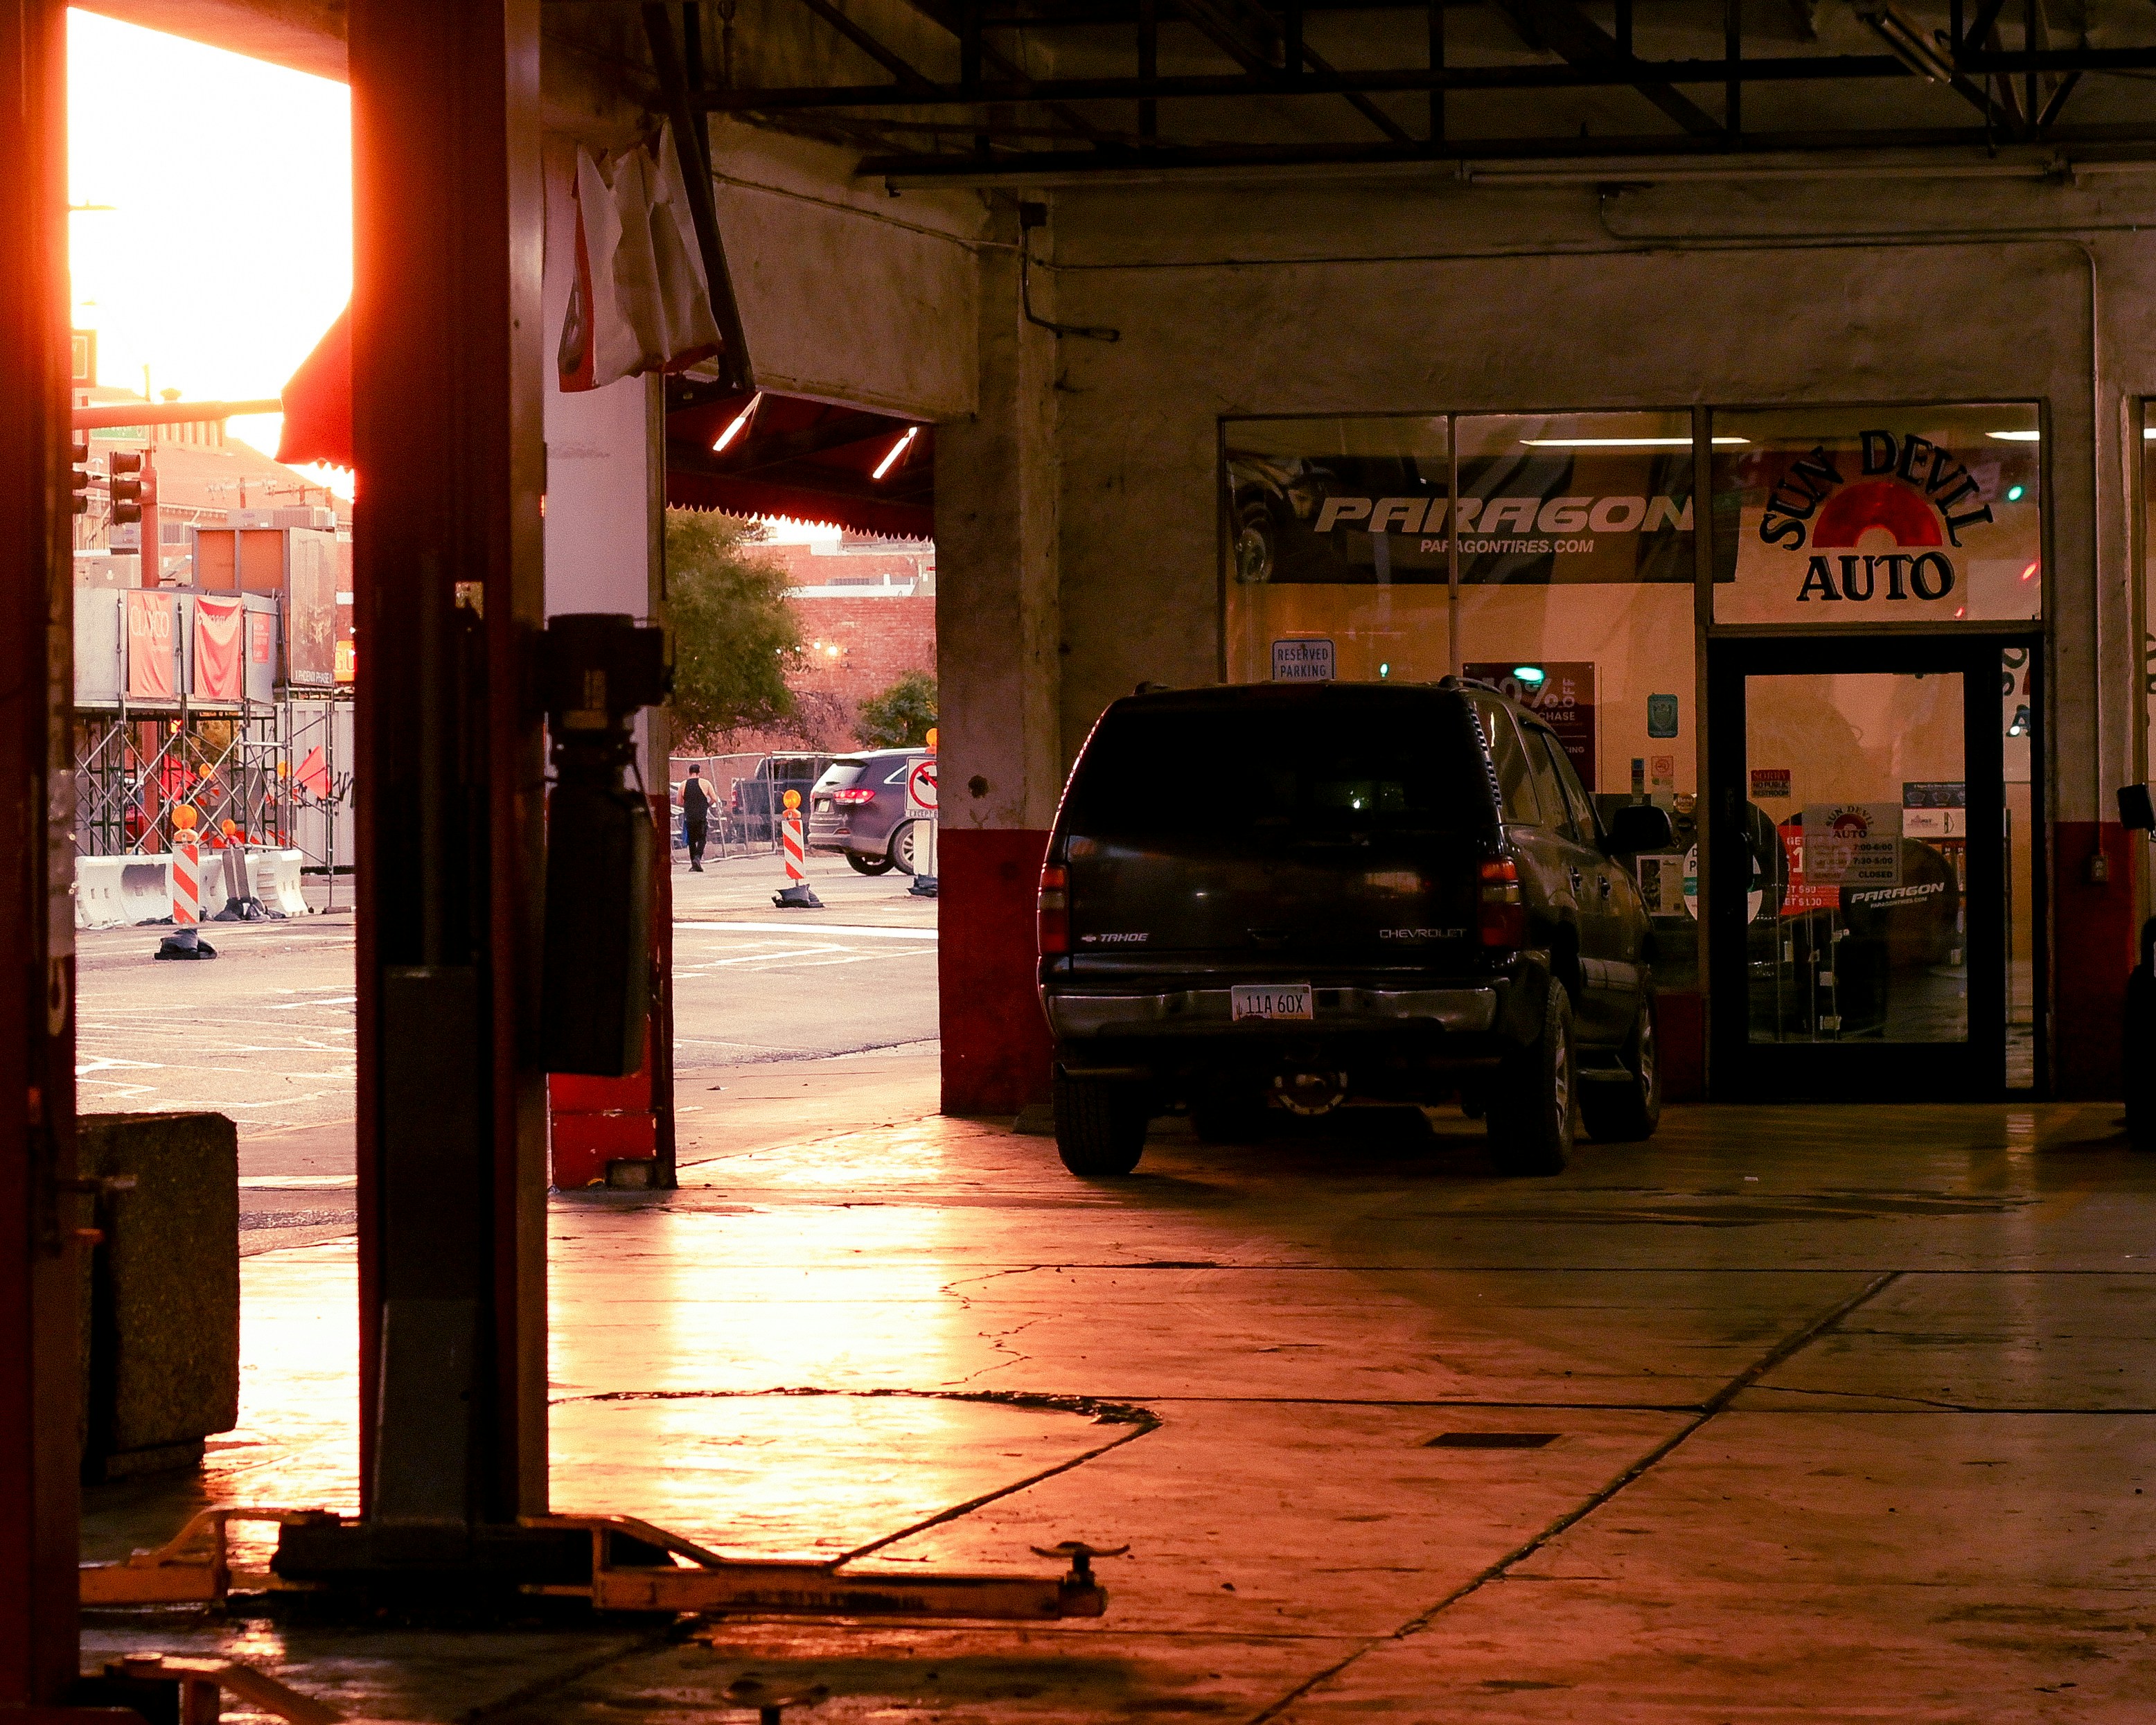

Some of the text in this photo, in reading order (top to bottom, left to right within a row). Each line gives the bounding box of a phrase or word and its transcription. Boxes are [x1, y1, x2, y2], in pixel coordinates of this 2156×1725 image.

[1759, 430, 1993, 551] SUN DEVIL
[1314, 496, 1695, 532] PARAGON
[1796, 551, 1954, 601] AUTO
[1278, 648, 1328, 661] RESERVED
[1280, 665, 1326, 678] PARKING
[1562, 678, 1575, 707] OFF
[1753, 771, 1786, 780] SORRY
[1825, 806, 1874, 826] SUN DEVIL
[1832, 830, 1867, 838] AUTO
[1851, 882, 1945, 904] PARAGON
[1100, 933, 1149, 942] TAHOE
[1379, 928, 1467, 938] CHEVROLET
[1246, 996, 1272, 1014] 11A
